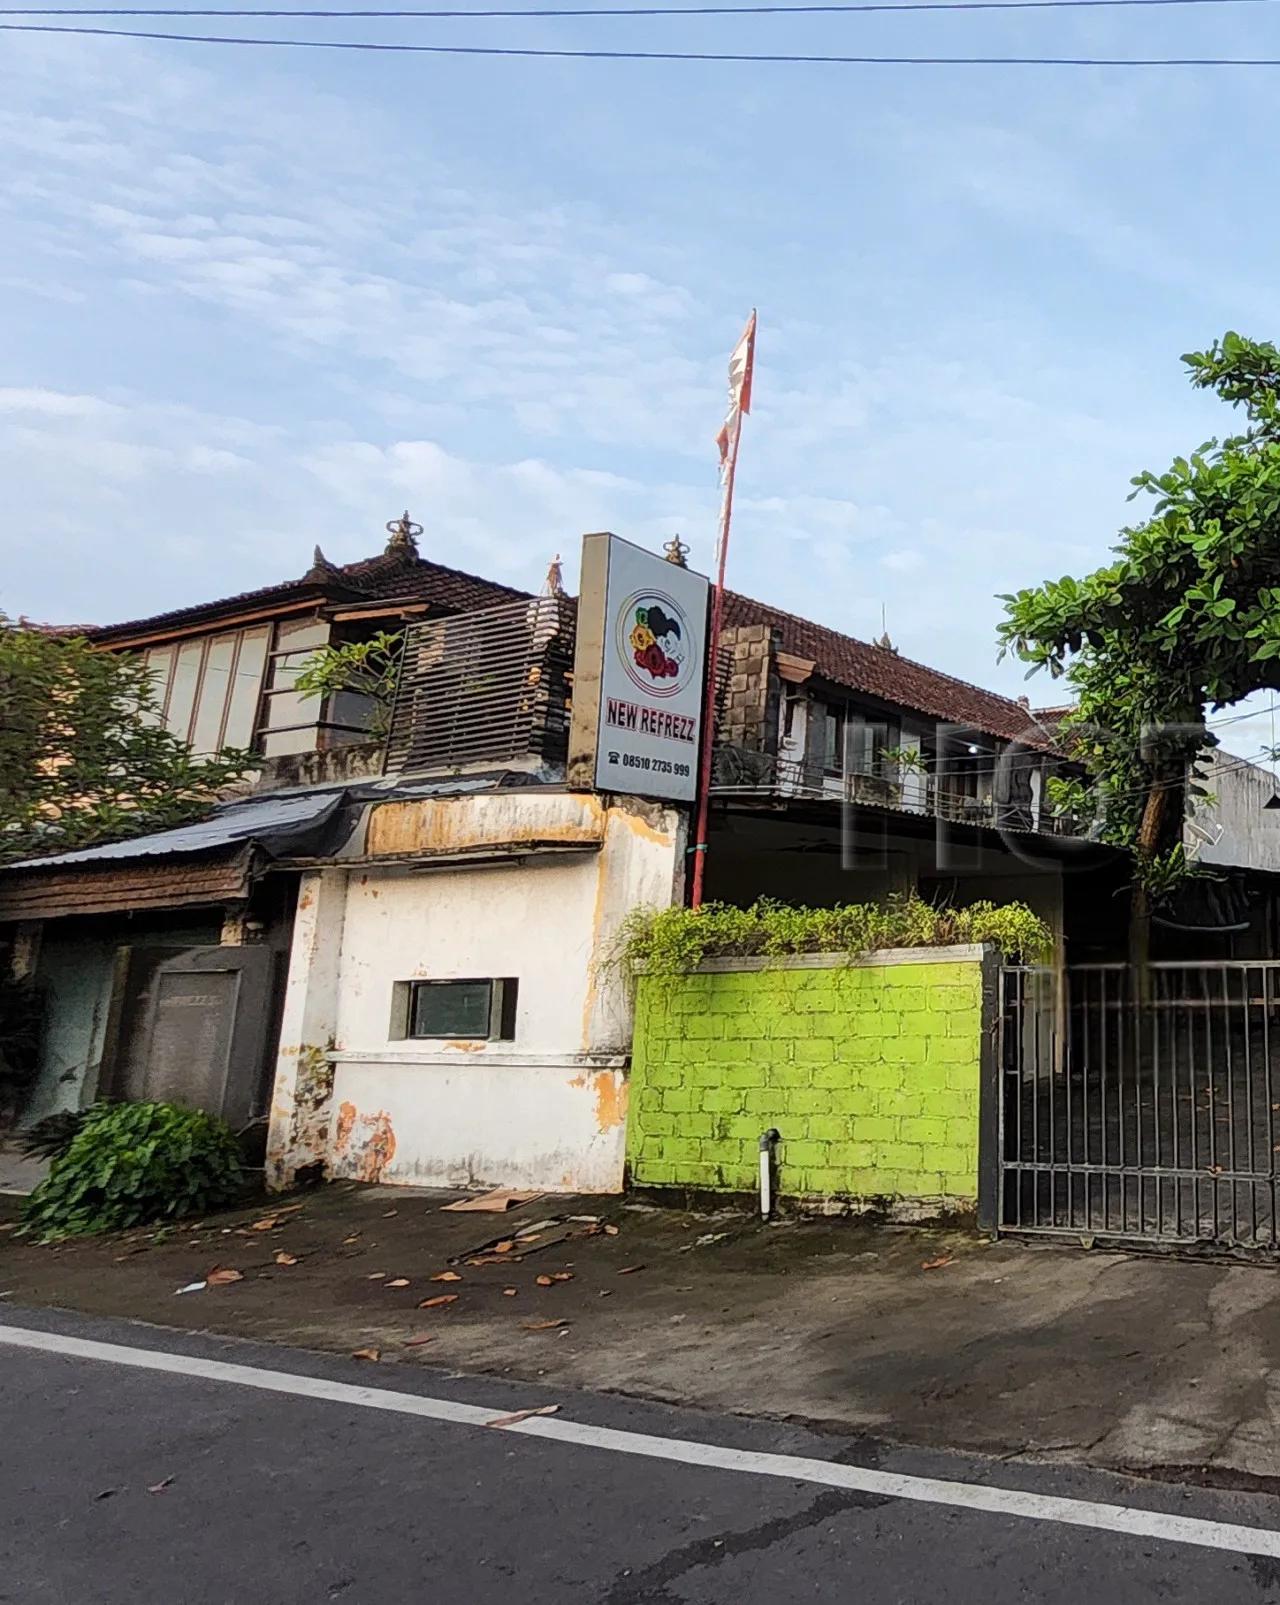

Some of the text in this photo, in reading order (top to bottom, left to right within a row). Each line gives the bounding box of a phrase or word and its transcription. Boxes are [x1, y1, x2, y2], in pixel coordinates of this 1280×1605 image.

[606, 699, 696, 743] NEW REFREZZ
[622, 753, 690, 777] 08510 2735 999
